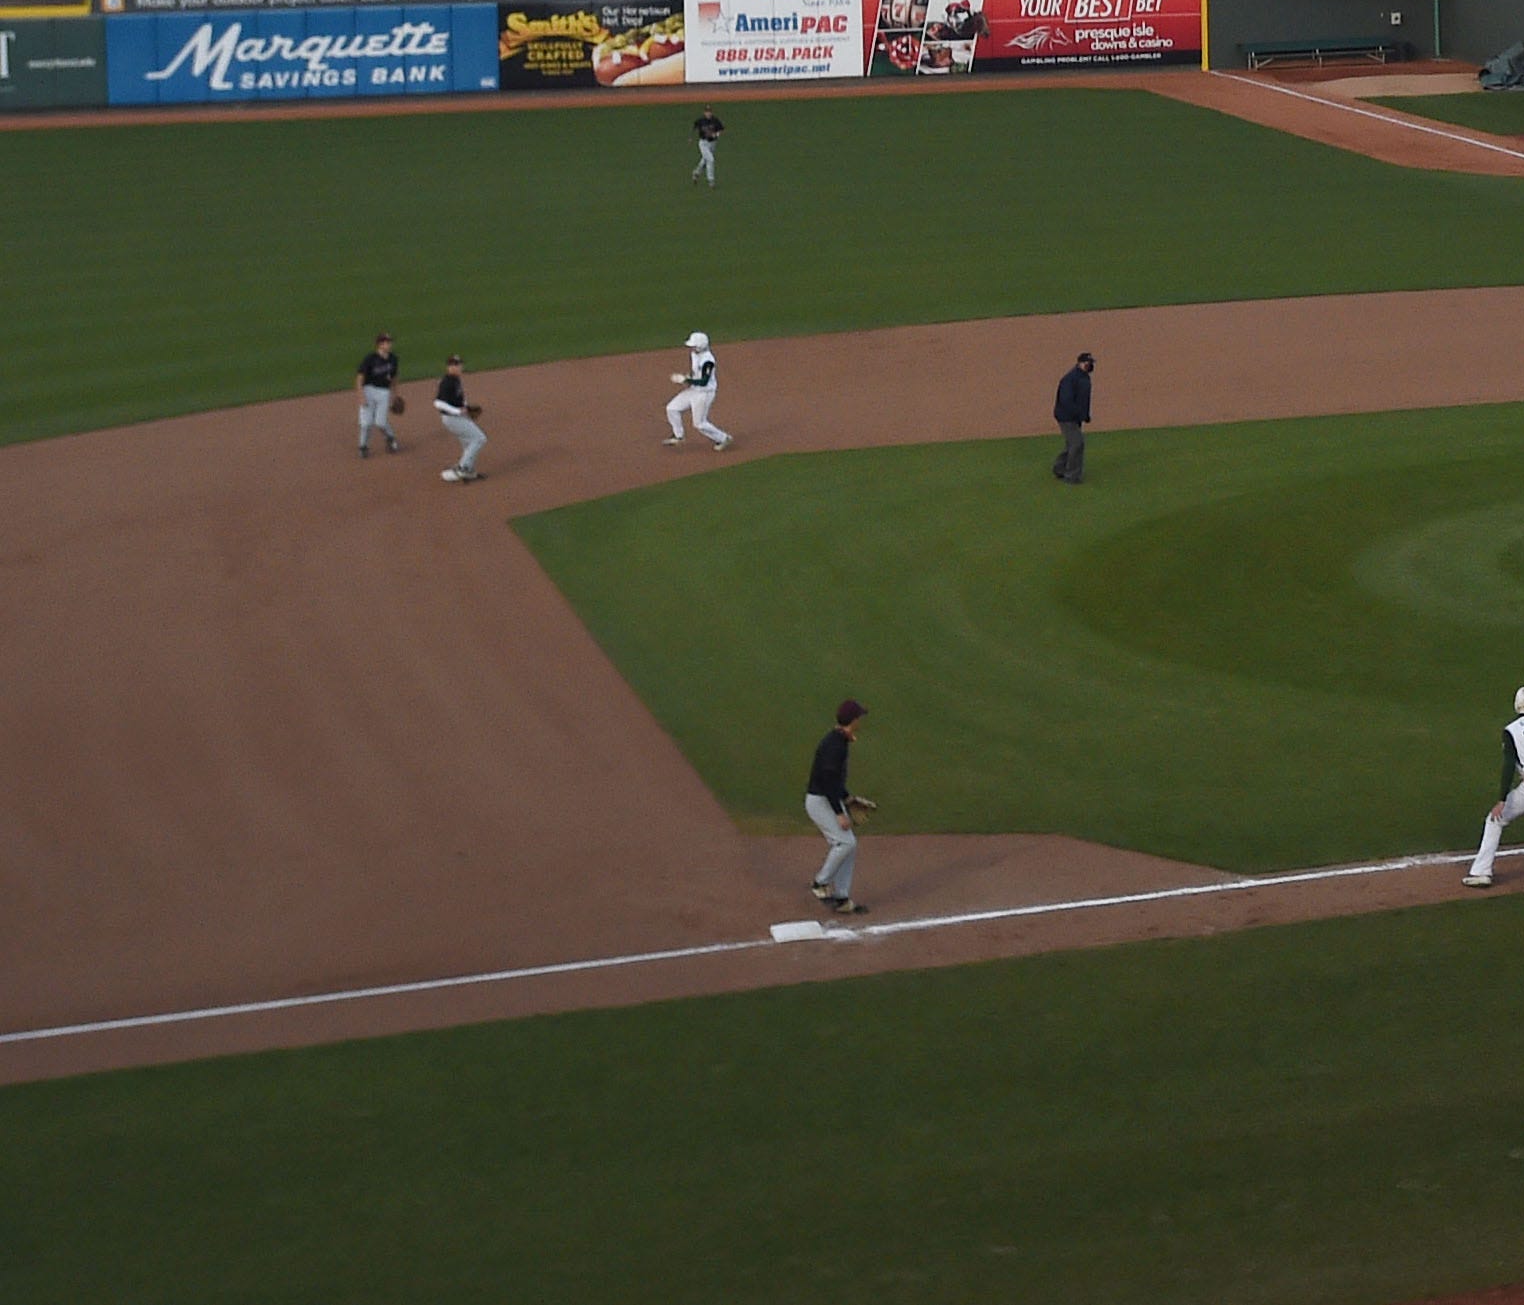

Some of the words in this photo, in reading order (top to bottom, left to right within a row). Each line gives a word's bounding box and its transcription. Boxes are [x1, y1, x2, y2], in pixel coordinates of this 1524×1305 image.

[735, 12, 849, 35] AmeriPAC
[1075, 26, 1131, 44] presque
[1132, 21, 1155, 38] isle
[1090, 37, 1127, 52] downs
[1138, 35, 1174, 49] casino
[145, 22, 449, 91] Marquette
[239, 67, 357, 90] SAVINGS
[371, 64, 447, 85] BANK
[718, 62, 831, 77] www.ameripac.net
